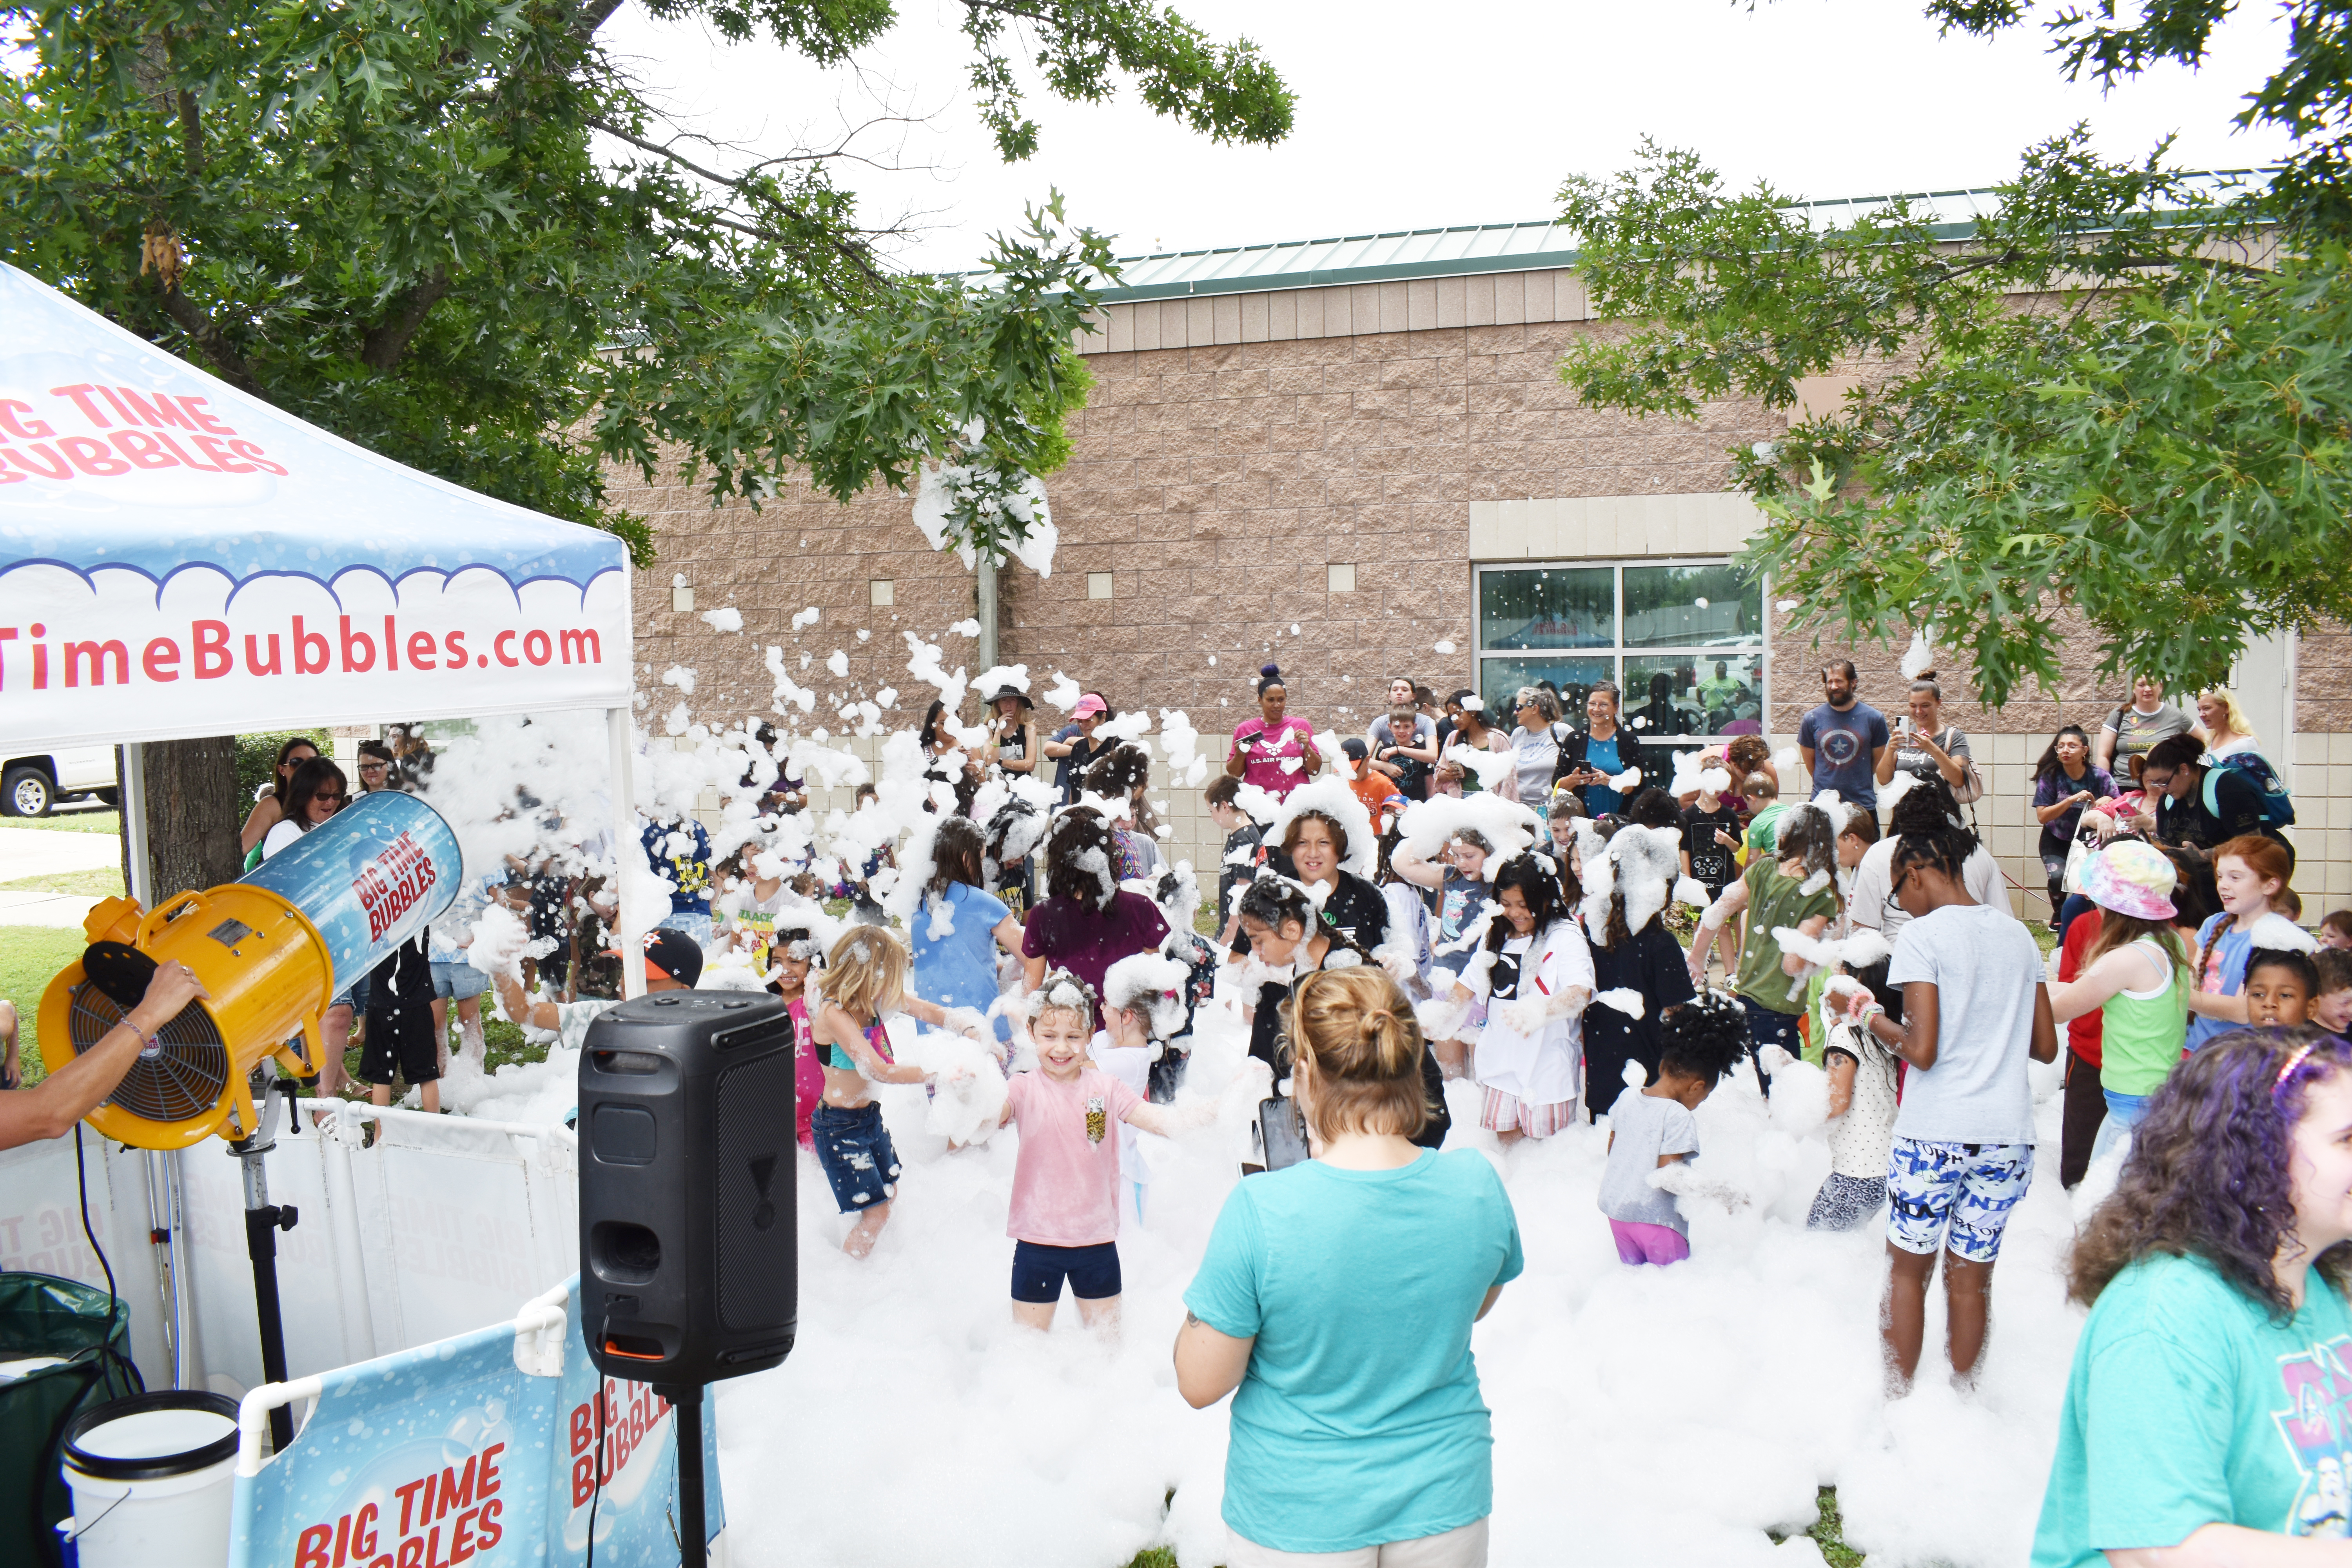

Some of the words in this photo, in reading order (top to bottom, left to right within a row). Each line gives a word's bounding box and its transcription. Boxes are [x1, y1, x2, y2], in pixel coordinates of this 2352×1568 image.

[50, 383, 237, 436] TIME
[0, 430, 289, 484] UBBLES
[352, 867, 387, 911] BIG
[377, 830, 424, 882] TIME
[369, 857, 436, 943] BUBBLES
[570, 1378, 618, 1458] BIG
[294, 1502, 379, 1568] BIG
[395, 1442, 505, 1537] TIME
